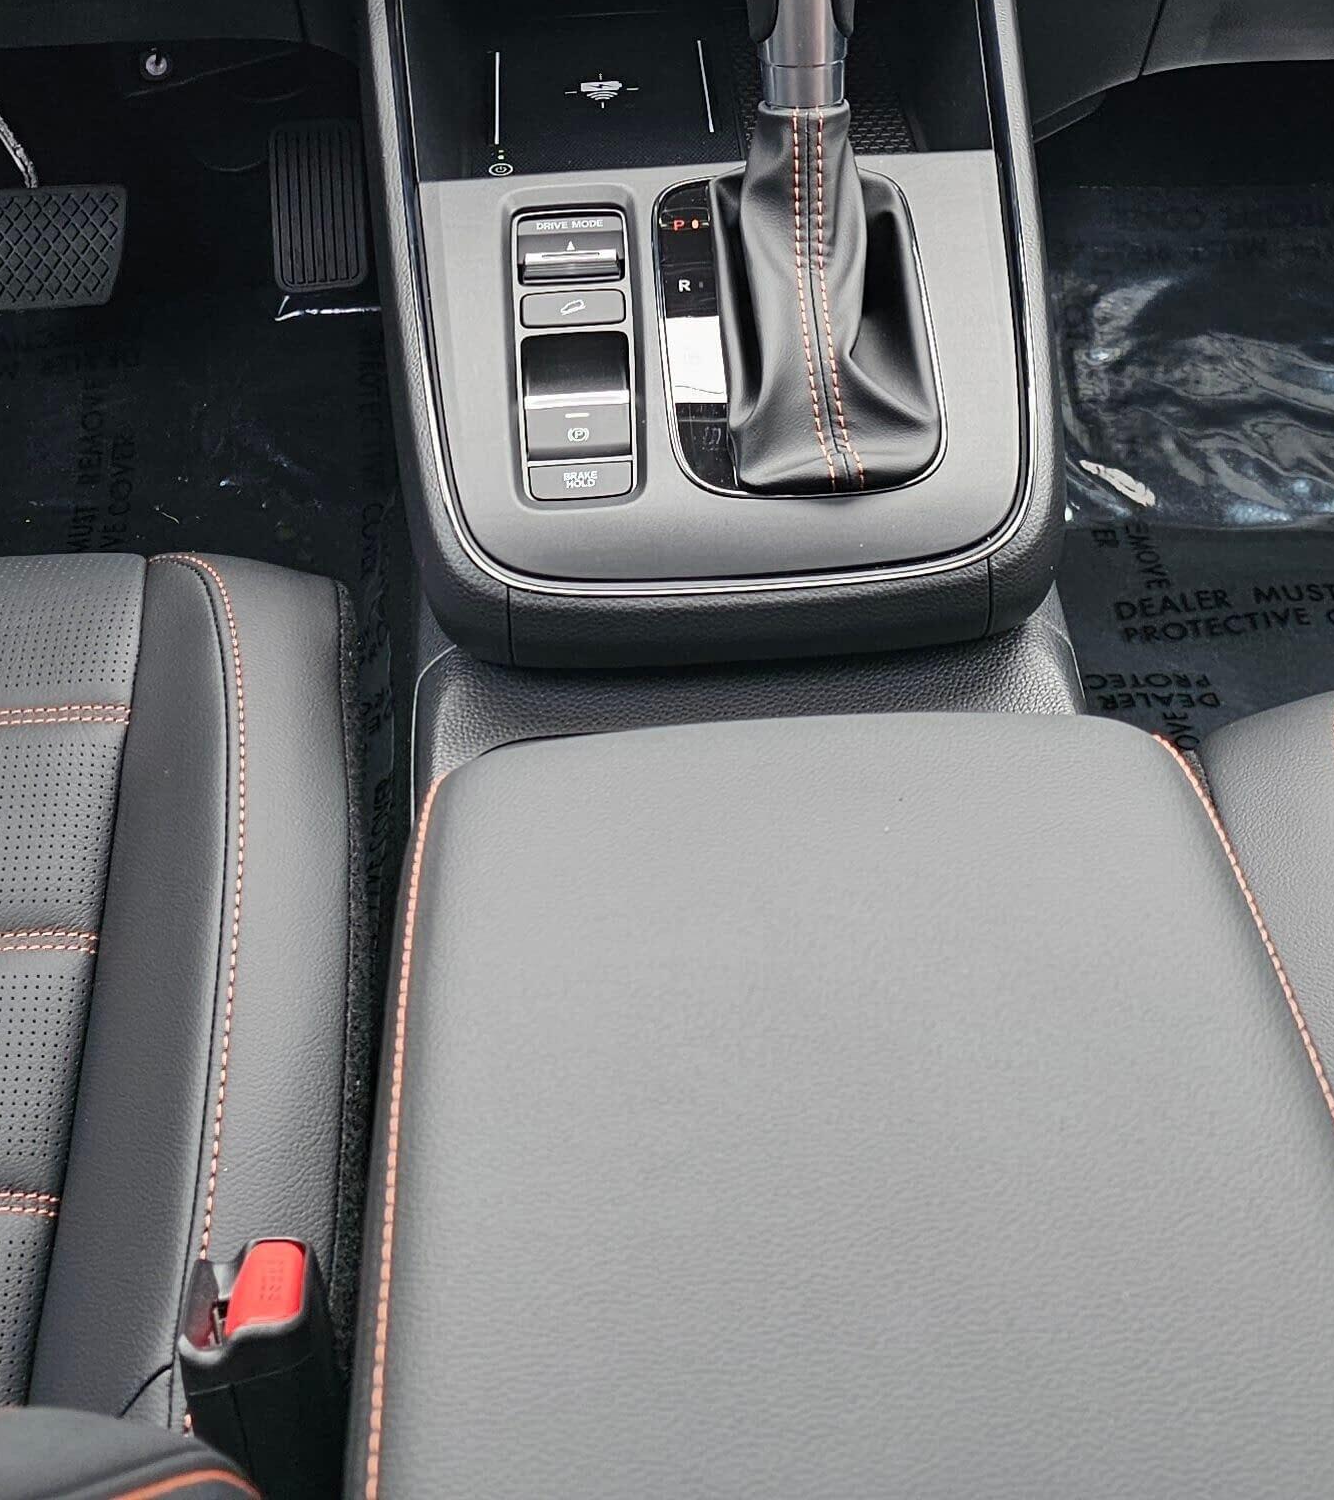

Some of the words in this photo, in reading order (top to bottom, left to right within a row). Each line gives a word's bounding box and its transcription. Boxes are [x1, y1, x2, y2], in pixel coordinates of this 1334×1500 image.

[536, 220, 568, 230] DRIVE
[571, 219, 604, 229] MODE
[673, 219, 685, 230] P
[678, 280, 691, 292] R
[563, 470, 598, 483] BRAKE
[566, 477, 596, 489] HOLD
[1113, 588, 1234, 623] DEALER
[1119, 606, 1314, 644] PROTECTIVE
[1096, 692, 1222, 712] DEALER
